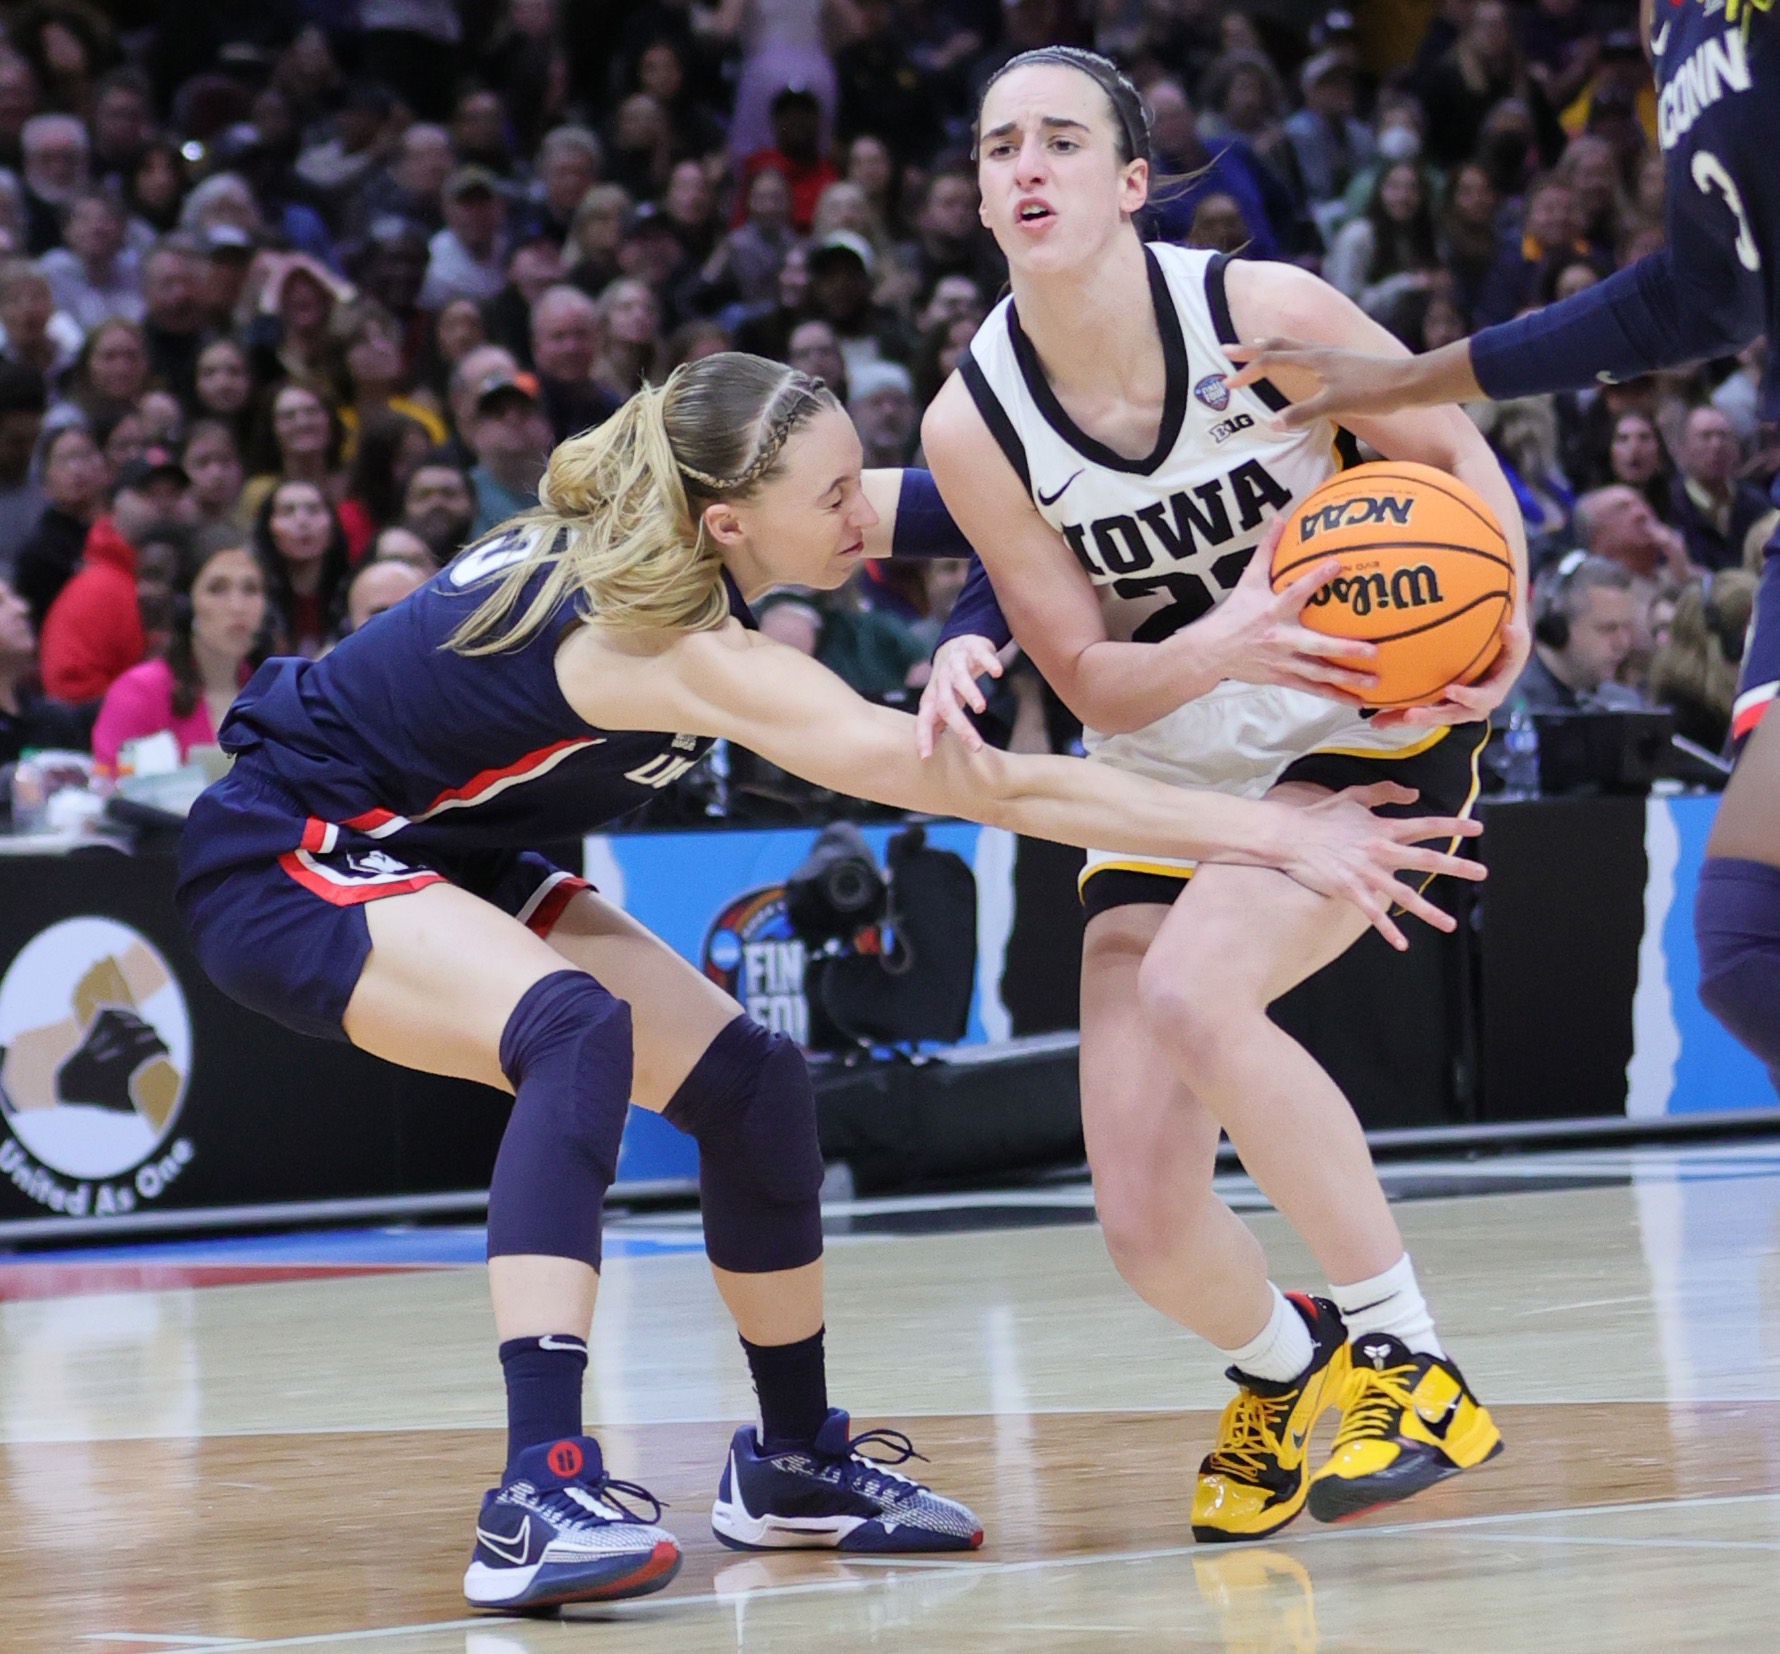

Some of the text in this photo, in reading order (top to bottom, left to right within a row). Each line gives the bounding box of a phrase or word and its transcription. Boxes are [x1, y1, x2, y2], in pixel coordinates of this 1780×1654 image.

[1657, 27, 1753, 150] CONN
[1691, 150, 1761, 272] 3
[1061, 457, 1293, 576] IOWA
[1300, 496, 1414, 543] NCAA
[1112, 544, 1259, 644] 2
[1304, 563, 1444, 616] Wilso
[743, 940, 806, 994] FIN
[0, 1137, 195, 1216] United As One
